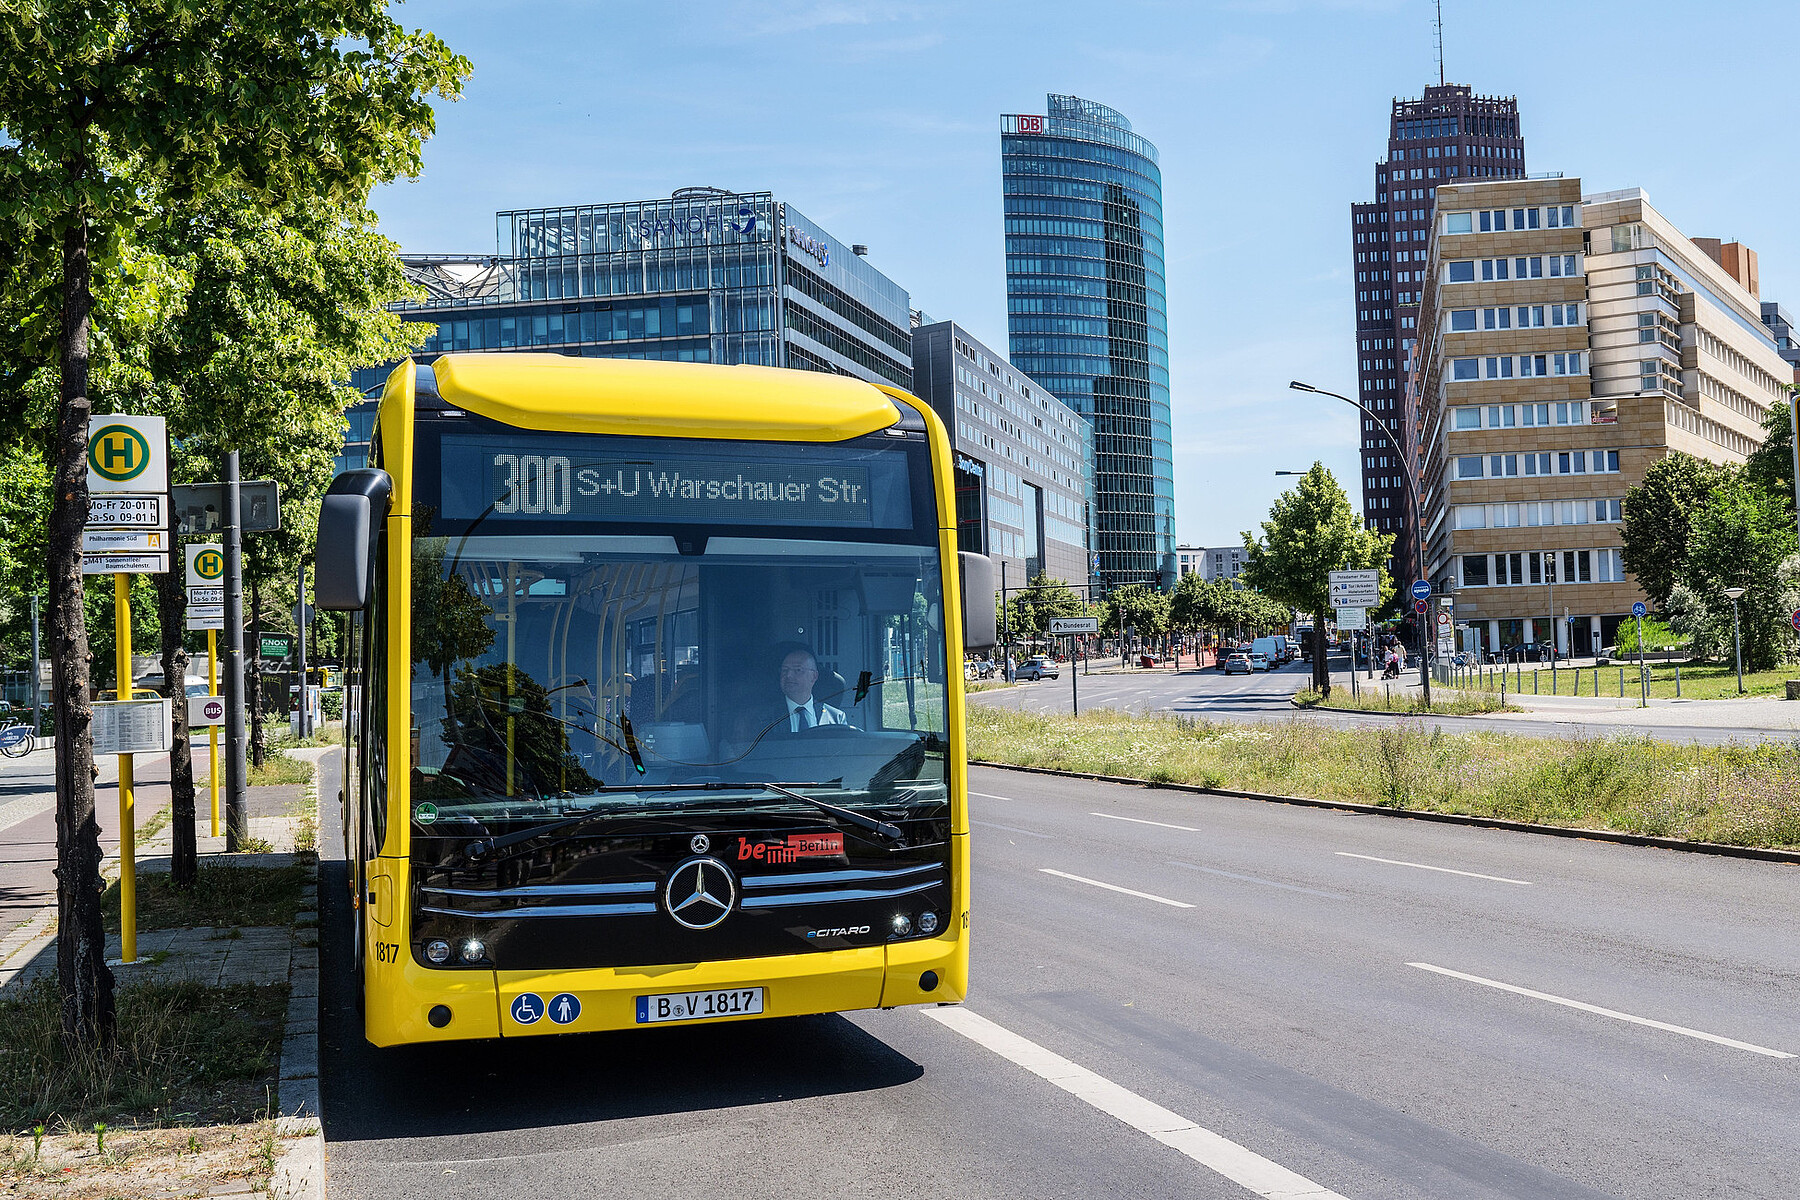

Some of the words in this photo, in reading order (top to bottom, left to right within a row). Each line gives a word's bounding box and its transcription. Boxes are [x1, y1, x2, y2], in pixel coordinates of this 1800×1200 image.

[1020, 117, 1040, 130] DB
[640, 213, 723, 237] SANOFI
[104, 438, 133, 468] H
[494, 453, 571, 515] 300
[577, 469, 641, 497] S+U
[647, 471, 810, 502] Warschauer
[818, 477, 868, 504] Str.
[120, 501, 146, 510] 20-01
[150, 501, 155, 510] h
[88, 513, 115, 522] Sa-So
[120, 513, 147, 522] 09-01
[150, 513, 156, 522] h
[149, 536, 159, 547] A
[203, 556, 218, 573] H
[205, 707, 222, 715] BUS
[424, 804, 430, 813] 4
[738, 837, 766, 860] be
[799, 839, 838, 852] Berlin
[806, 926, 870, 938] eCITARO
[376, 941, 400, 964] 1817
[658, 998, 670, 1018] B
[686, 995, 698, 1015] V
[704, 991, 754, 1015] 1817
